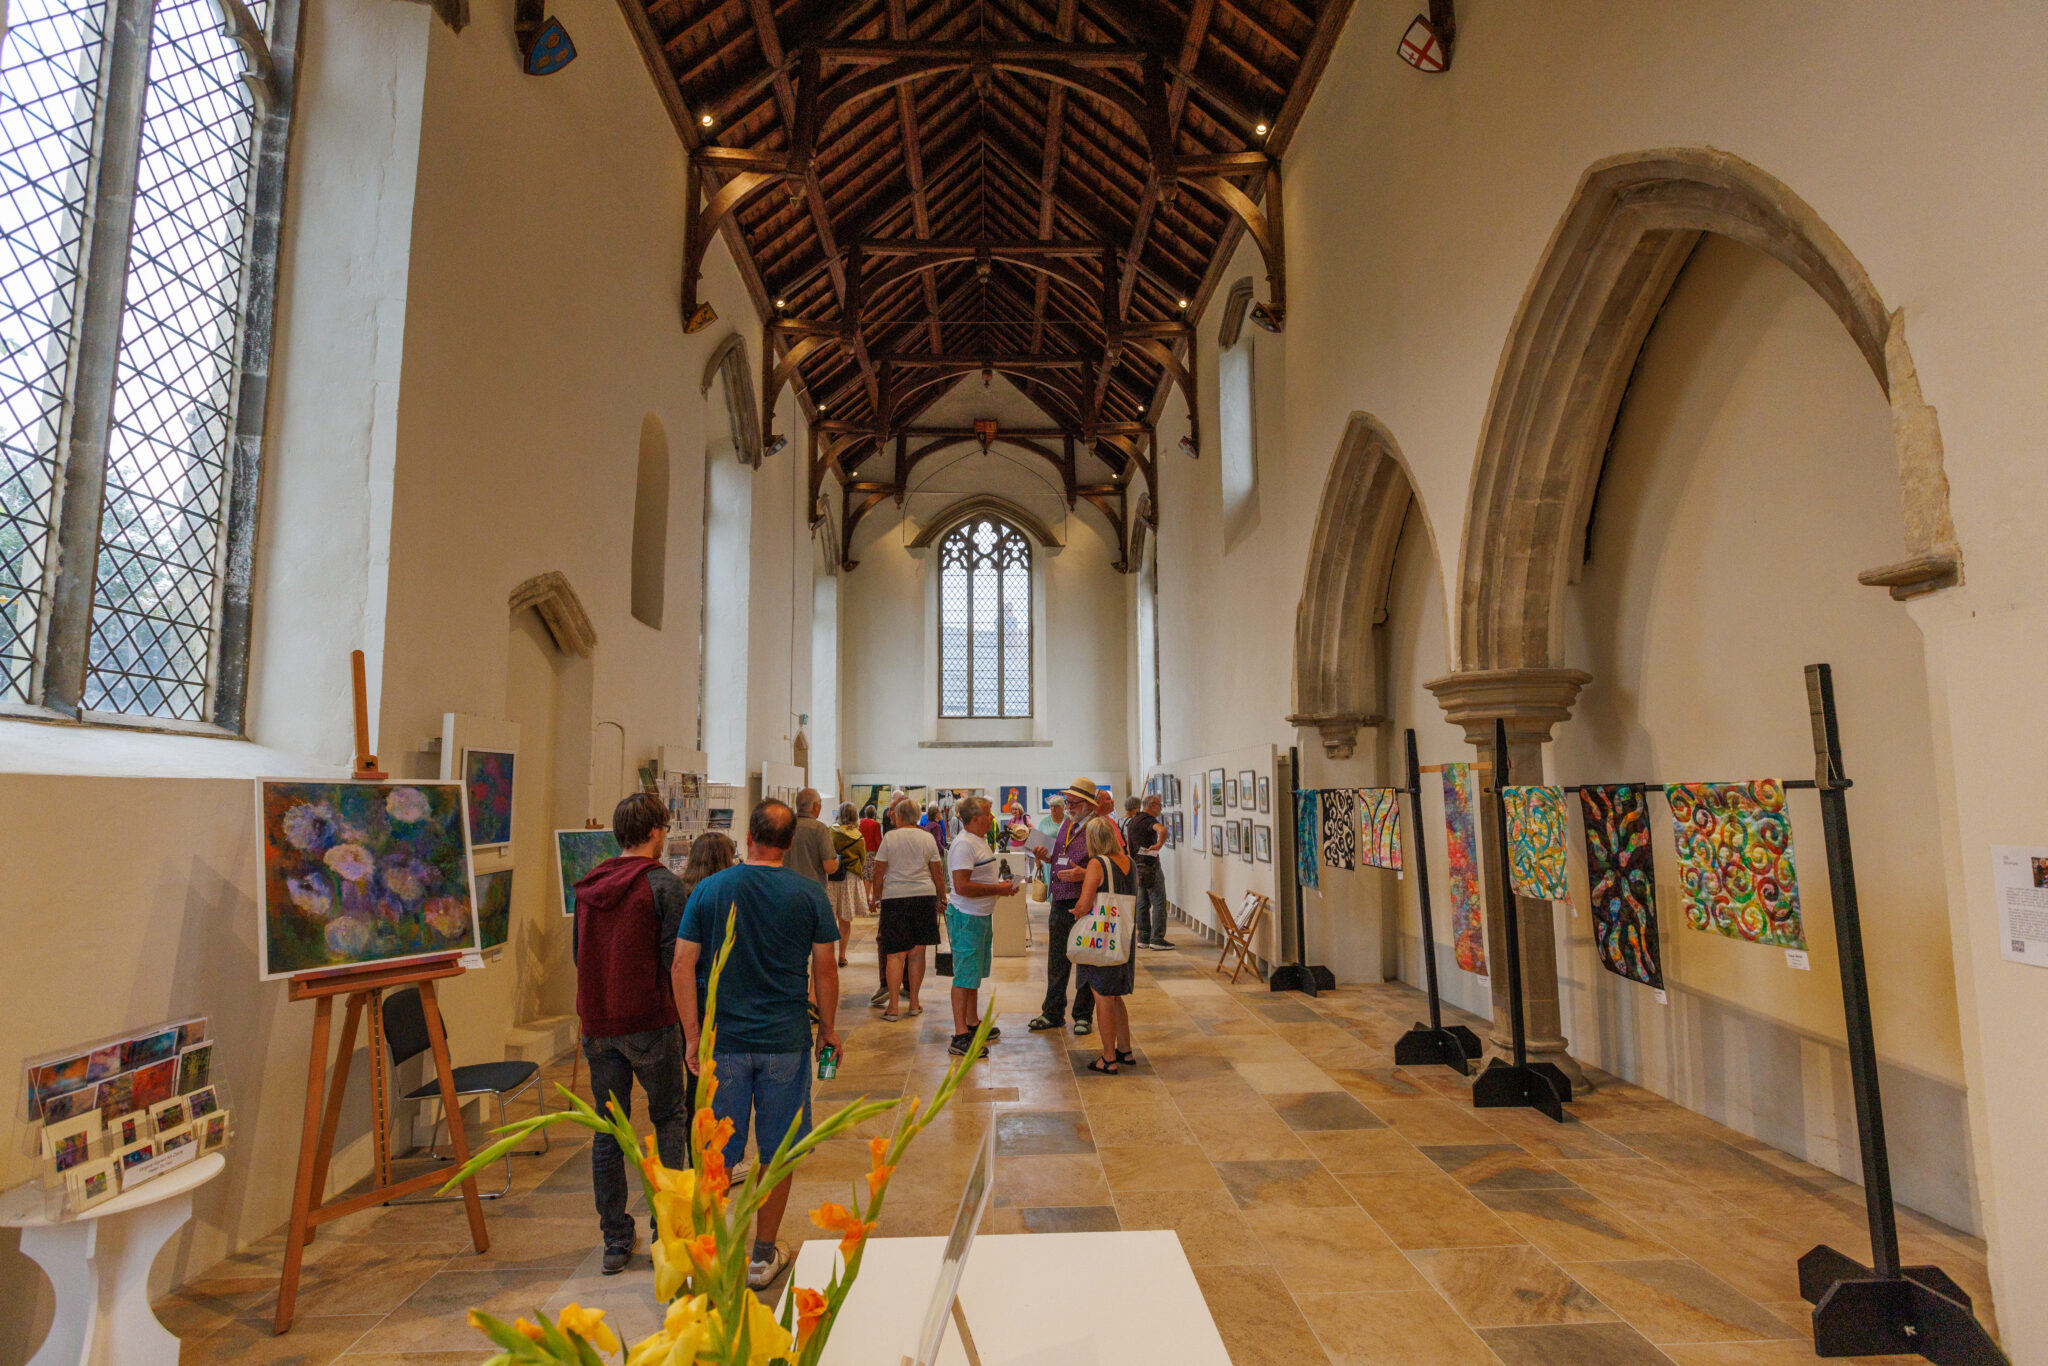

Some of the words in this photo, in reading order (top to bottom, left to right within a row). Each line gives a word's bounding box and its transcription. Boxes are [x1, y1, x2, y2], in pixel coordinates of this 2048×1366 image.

[1089, 905, 1120, 918] LWAYS.
[1085, 920, 1117, 934] CARRY
[1075, 935, 1119, 951] SNACKS.
